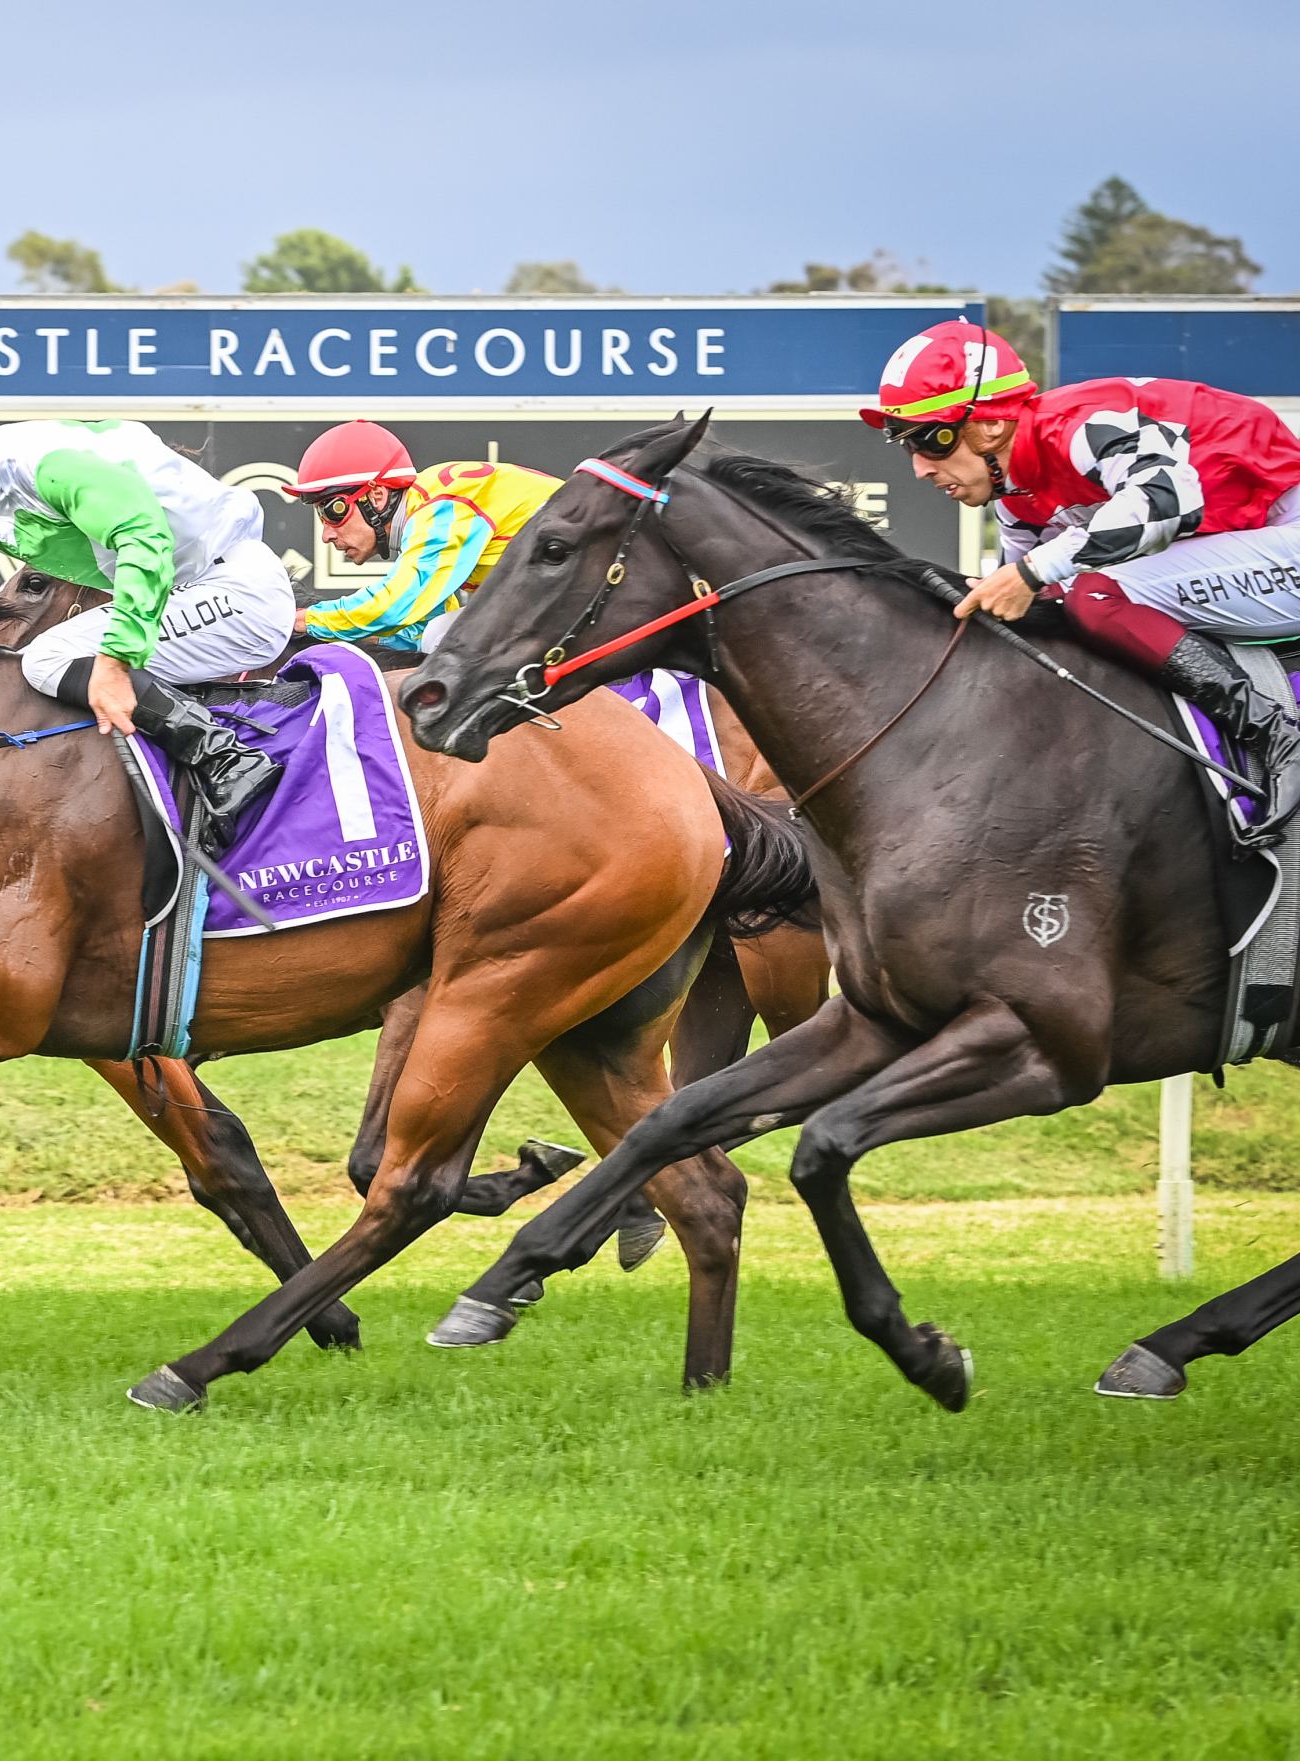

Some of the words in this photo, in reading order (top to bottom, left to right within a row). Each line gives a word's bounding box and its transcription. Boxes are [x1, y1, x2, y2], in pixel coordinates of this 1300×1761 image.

[208, 327, 726, 377] RACECOURSE
[1176, 574, 1230, 606] ASH
[309, 671, 378, 842] 1
[237, 840, 417, 892] NEWCASTLE
[262, 870, 399, 904] RACECOURSE
